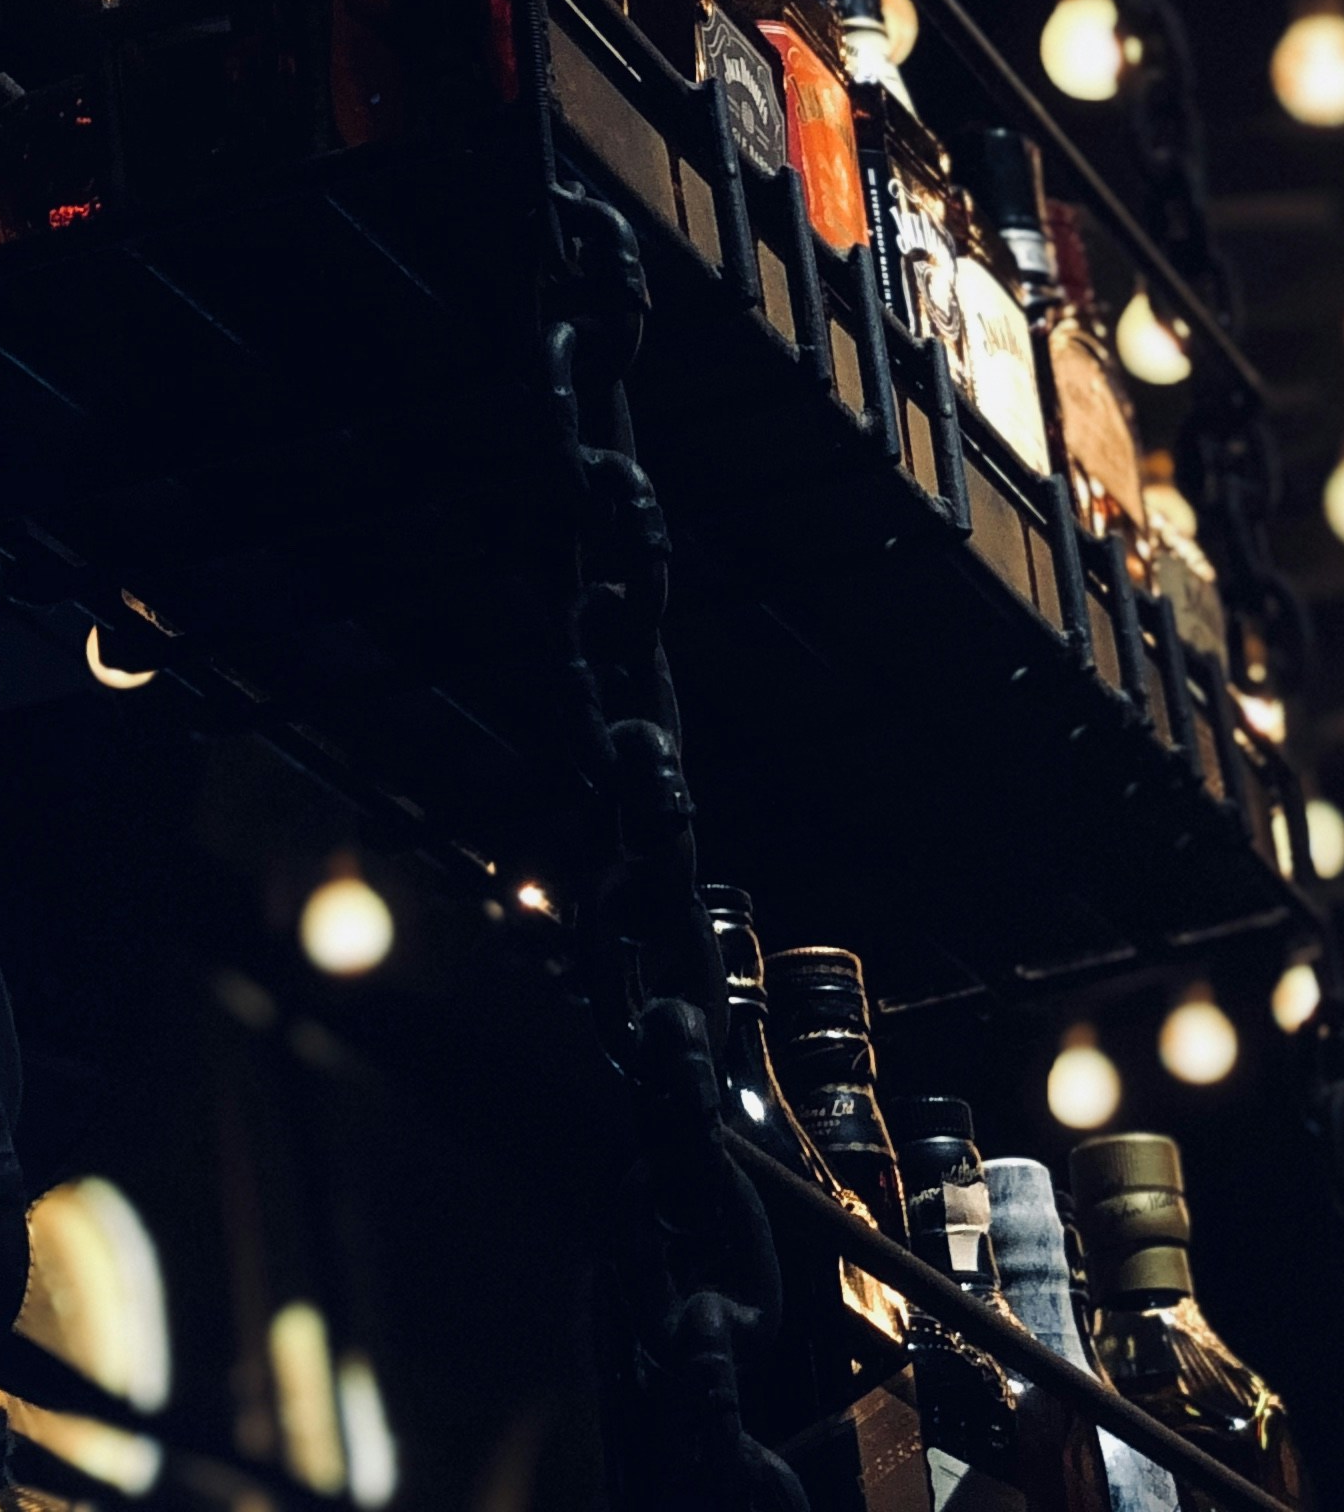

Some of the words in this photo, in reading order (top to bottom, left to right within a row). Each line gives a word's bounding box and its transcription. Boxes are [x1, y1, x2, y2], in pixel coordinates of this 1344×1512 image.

[870, 189, 882, 226] EVERY
[876, 225, 886, 257] DROP
[879, 256, 890, 287] MADE
